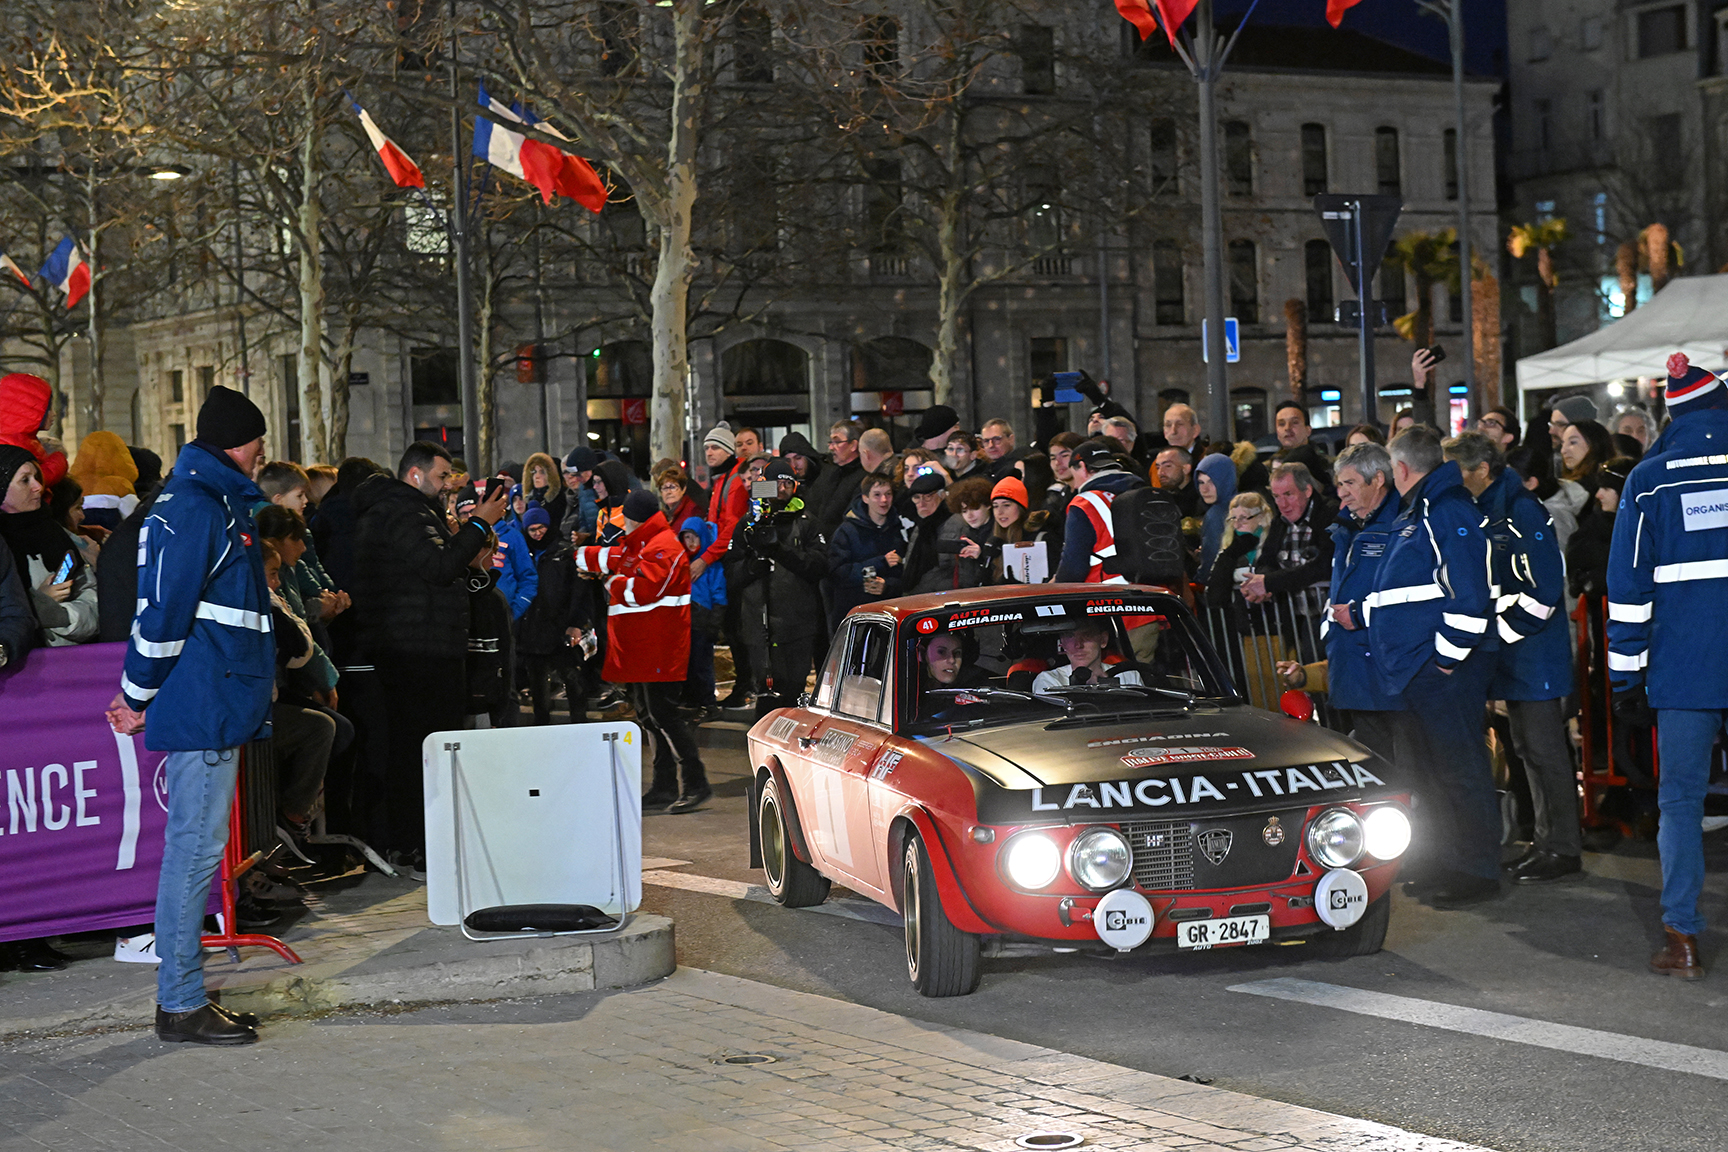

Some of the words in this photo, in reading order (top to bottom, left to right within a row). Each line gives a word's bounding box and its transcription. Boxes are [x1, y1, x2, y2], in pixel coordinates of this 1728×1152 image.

[1685, 503, 1728, 516] ORGANIS
[949, 609, 990, 620] AUTO
[1086, 605, 1155, 614] ENGIADINA
[922, 620, 934, 631] 41
[948, 613, 1023, 628] ENGIADINA
[623, 731, 632, 745] 4
[1087, 732, 1230, 748] ENGIADINA
[0, 760, 100, 836] NCE
[1147, 835, 1164, 847] HF
